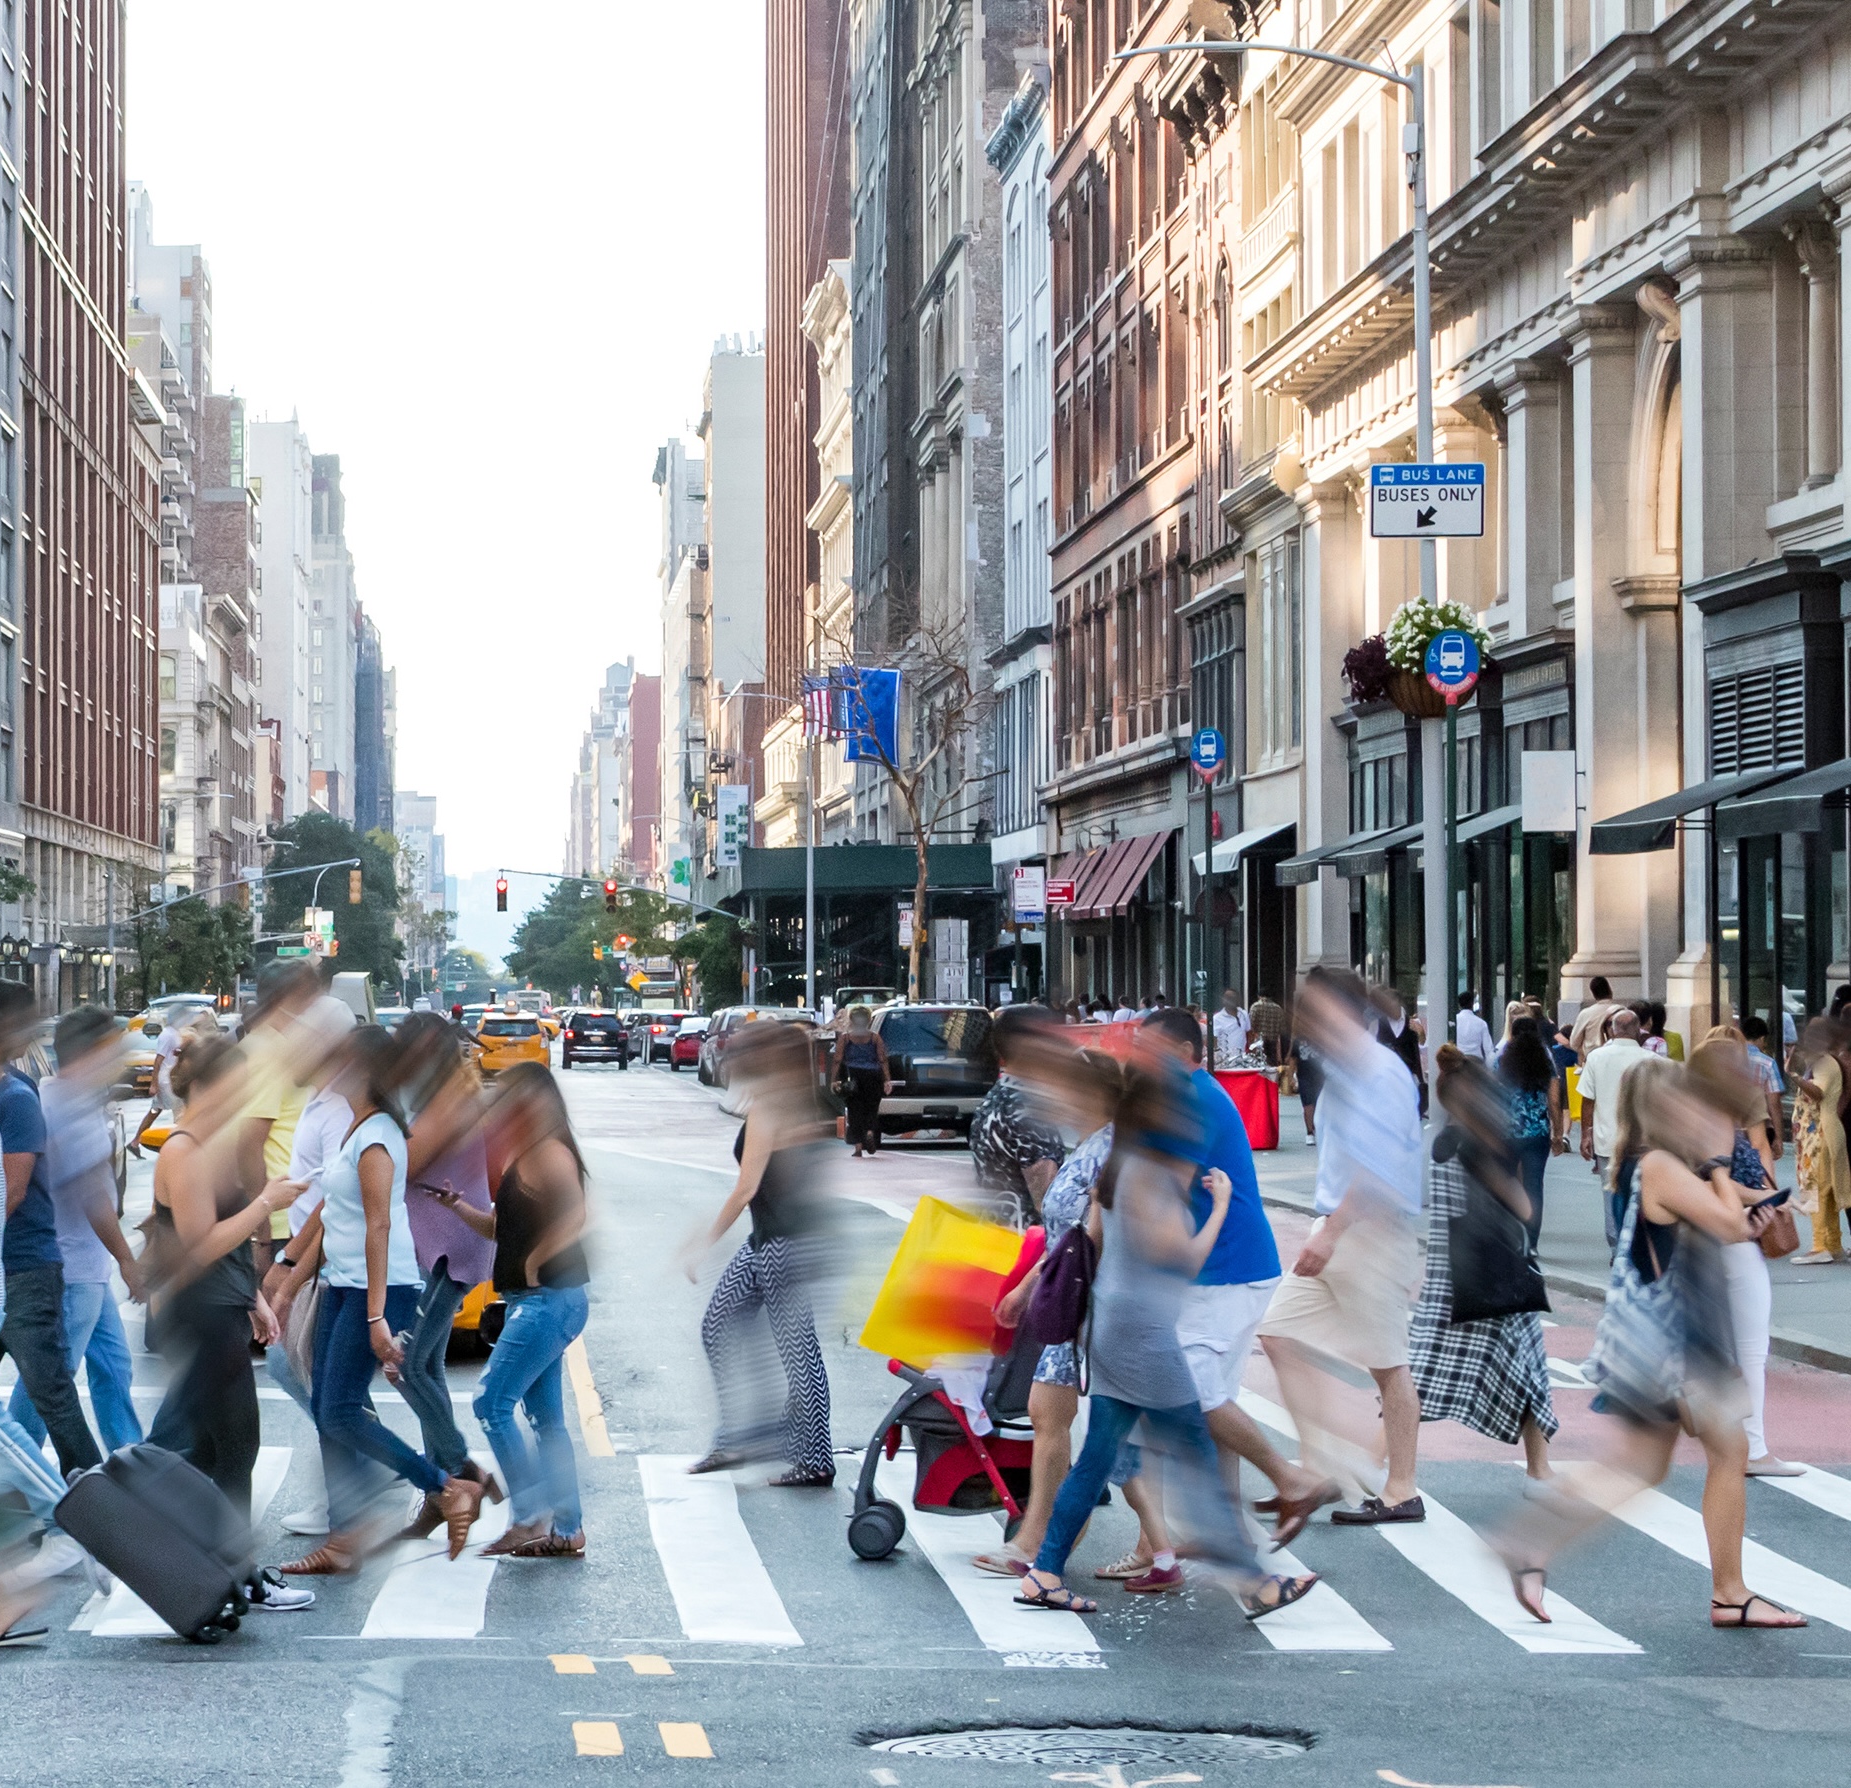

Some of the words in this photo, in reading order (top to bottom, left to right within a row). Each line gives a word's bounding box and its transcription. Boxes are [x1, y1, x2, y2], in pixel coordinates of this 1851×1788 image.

[1401, 468, 1431, 481] BUS
[1436, 468, 1477, 481] LANE
[1377, 488, 1430, 502] BUSES
[1438, 487, 1478, 501] ONLY
[1439, 675, 1472, 692] STANDING
[829, 1041, 837, 1053] 2
